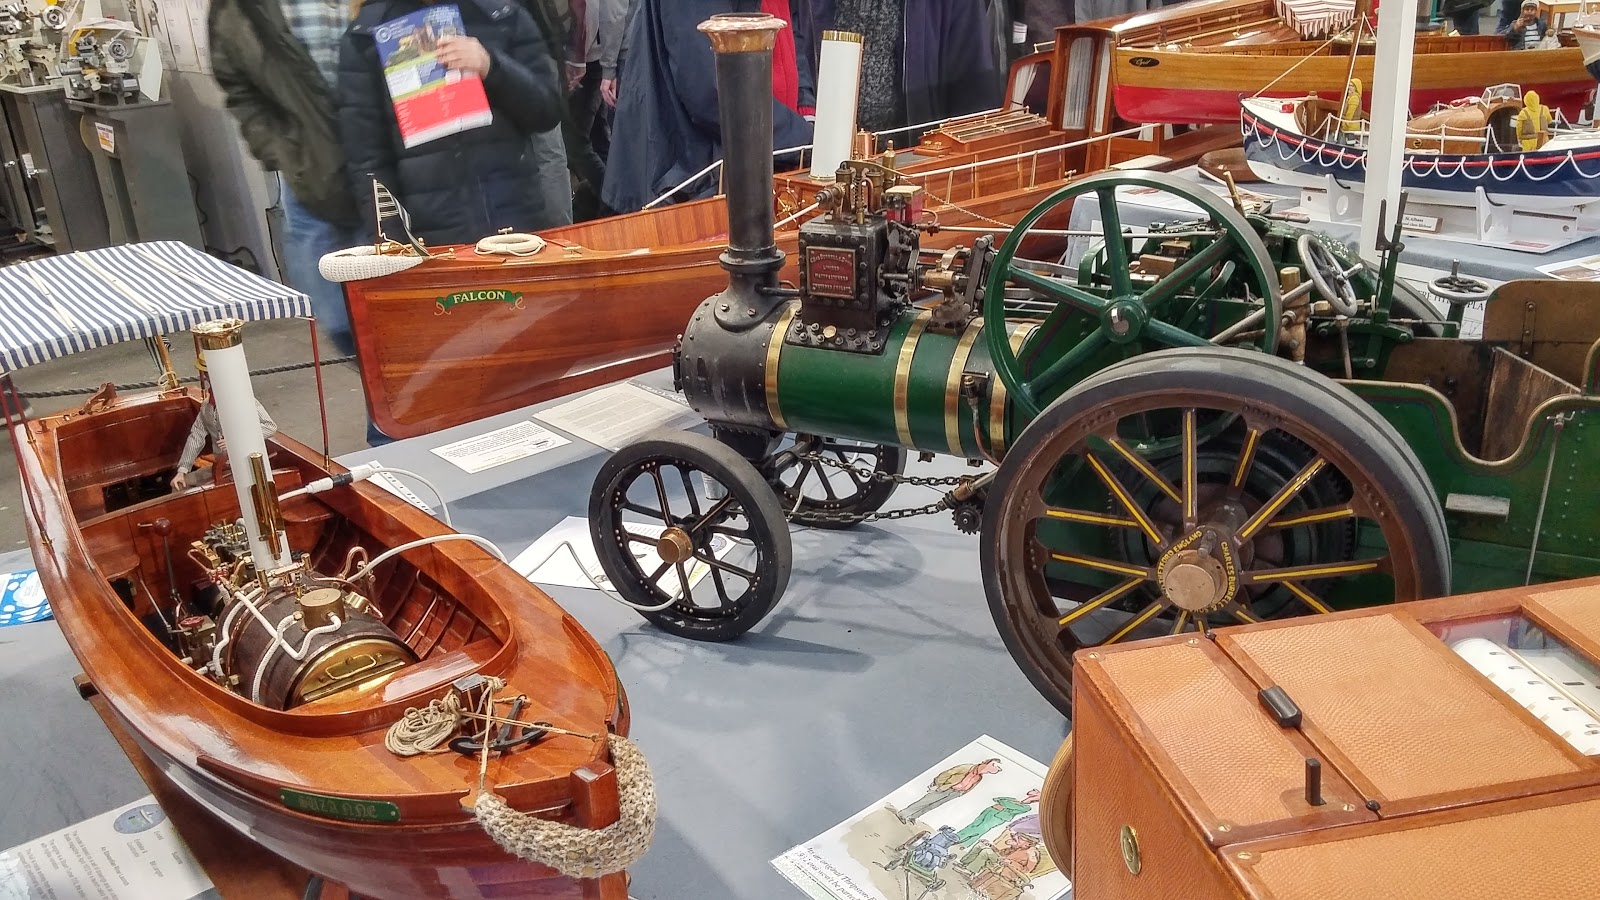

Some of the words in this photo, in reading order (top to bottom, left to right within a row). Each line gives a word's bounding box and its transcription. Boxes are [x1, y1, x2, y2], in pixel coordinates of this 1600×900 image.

[453, 290, 506, 304] FALCON
[1173, 530, 1203, 553] ENGLAND
[1221, 541, 1235, 576] CHARLES
[1218, 576, 1236, 608] BURRELL
[819, 858, 843, 877] original
[832, 879, 841, 888] be
